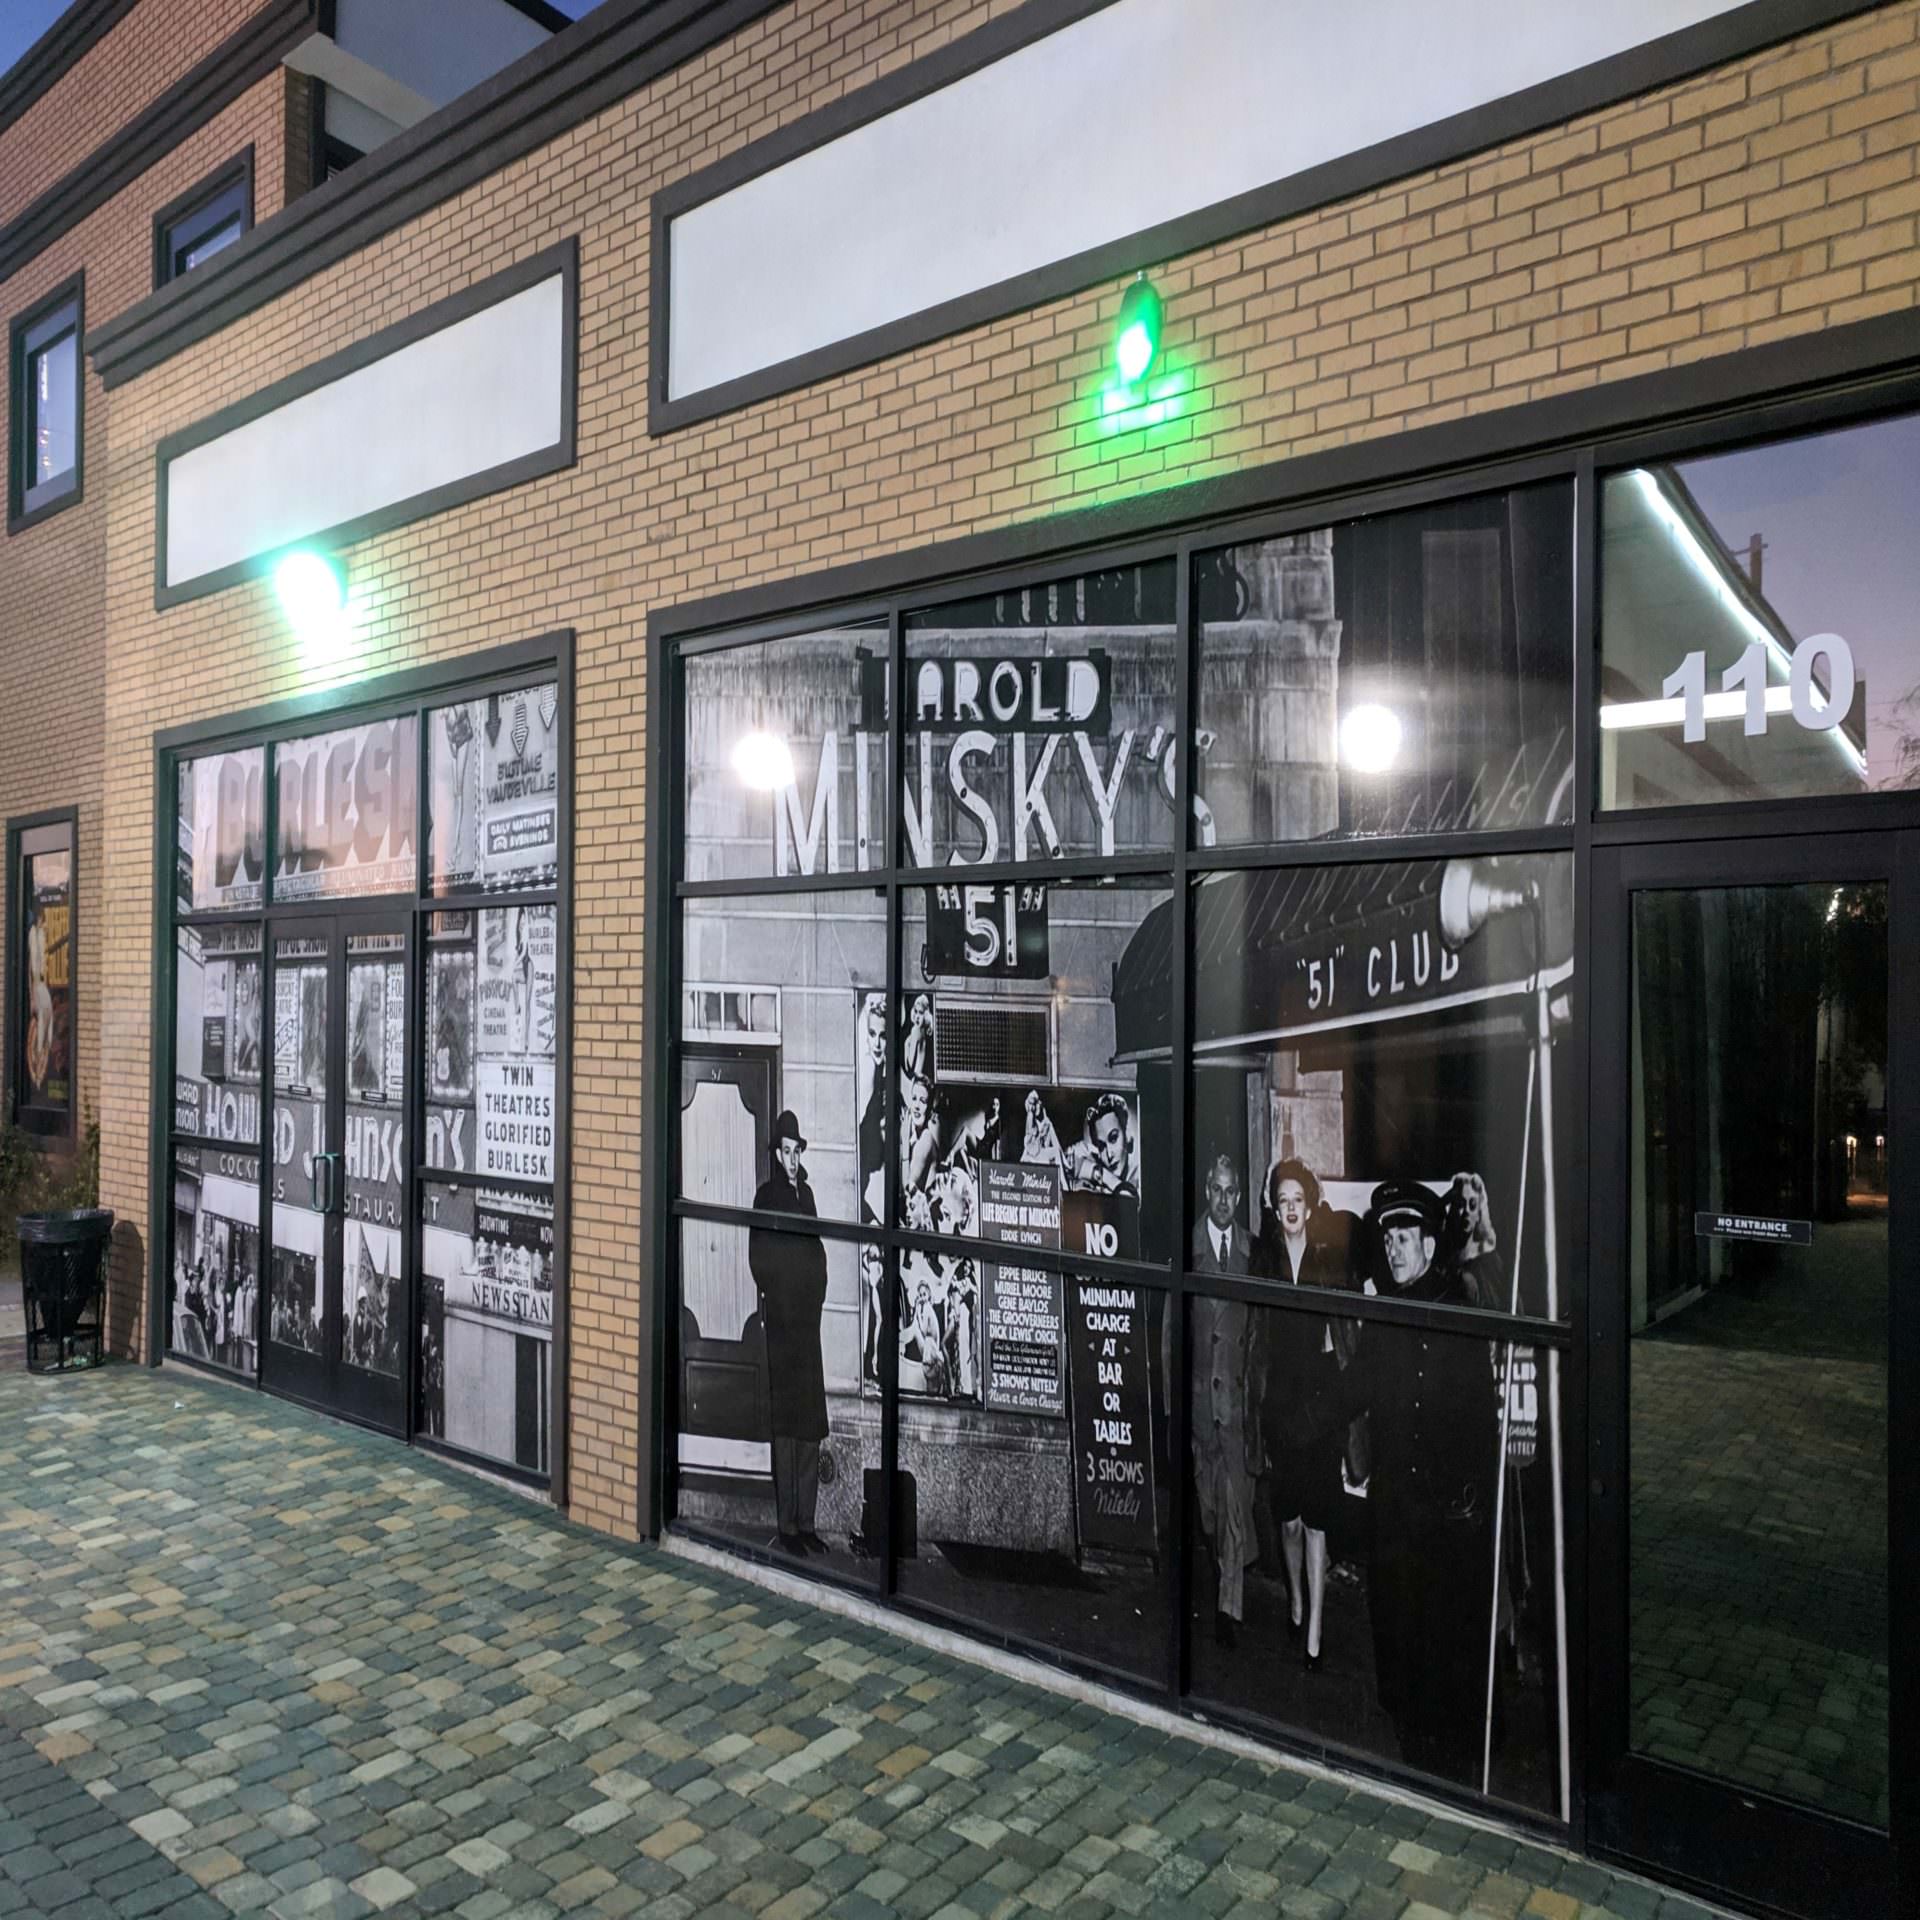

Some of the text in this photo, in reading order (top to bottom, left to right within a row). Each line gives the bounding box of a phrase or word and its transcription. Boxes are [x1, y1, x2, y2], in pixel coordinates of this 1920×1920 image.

[884, 659, 1100, 722] AROLD
[1663, 633, 1855, 743] 110
[487, 773, 556, 804] VAUDEVILLE
[501, 1065, 534, 1087] TWIN
[485, 1093, 551, 1118] THEATRES
[485, 1121, 551, 1147] GLORIFIED
[487, 1149, 548, 1177] BURLESK
[1022, 1171, 1052, 1194] Minsky
[479, 1214, 510, 1235] SHOWTIME
[1717, 1217, 1788, 1232] NO ENTRANCE
[1001, 1229, 1042, 1245] EDDIE LYNCH
[1084, 1223, 1118, 1257] NO
[1022, 1268, 1047, 1284] BRUCE
[994, 1280, 1052, 1299] MURIEL MOORE
[1079, 1286, 1135, 1309] MINIMUM
[998, 1295, 1049, 1314] GENE BAYLOS
[989, 1309, 1001, 1323] THE
[1086, 1312, 1131, 1333] CHARGE
[990, 1323, 1007, 1340] DICK
[1102, 1338, 1117, 1357] AT
[991, 1372, 1058, 1394] 3 SHOWS NITELY
[1097, 1361, 1123, 1386] BAR
[1103, 1392, 1120, 1412] OR
[1093, 1418, 1132, 1445] TABLES
[1086, 1450, 1145, 1485] 3 SHOWS
